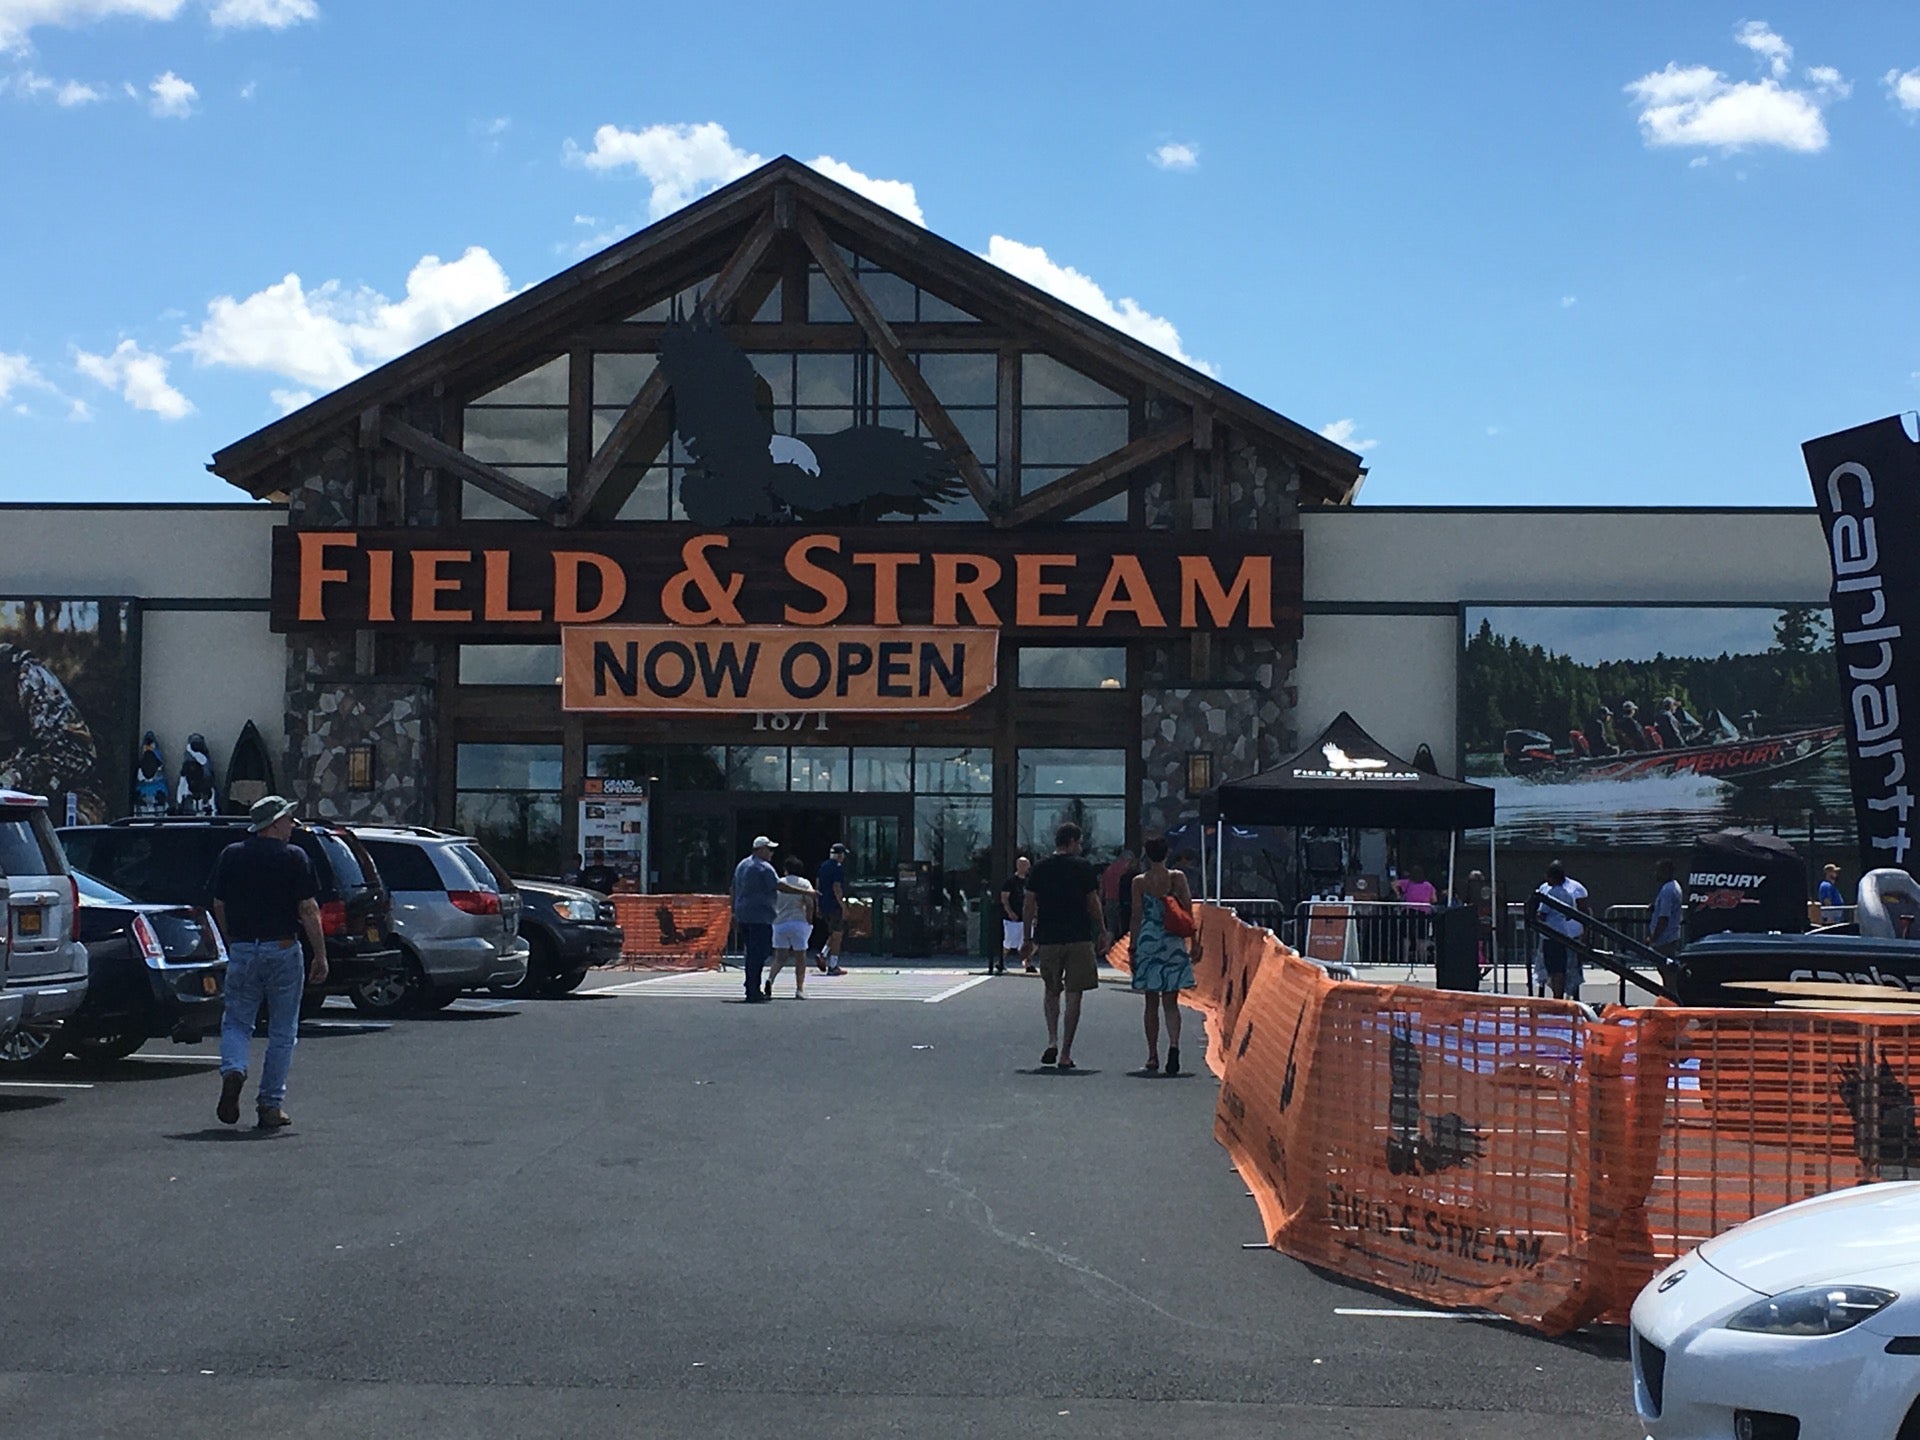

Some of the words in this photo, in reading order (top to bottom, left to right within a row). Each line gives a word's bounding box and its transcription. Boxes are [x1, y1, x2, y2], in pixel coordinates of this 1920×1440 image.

[297, 532, 627, 622] FIELD
[661, 534, 745, 625] &
[784, 534, 1275, 629] STREAM
[594, 640, 761, 699] NOW
[780, 640, 965, 699] OPEN
[1827, 461, 1914, 863] carhartt
[1293, 769, 1337, 777] FIELD
[1355, 771, 1419, 779] STREAM
[1673, 745, 1781, 775] MERCURY
[1688, 873, 1766, 888] MERCURY
[1689, 893, 1709, 903] Pro
[1327, 1182, 1393, 1238] FIELD
[1400, 1204, 1418, 1247] &
[1424, 1210, 1544, 1270] STREAM
